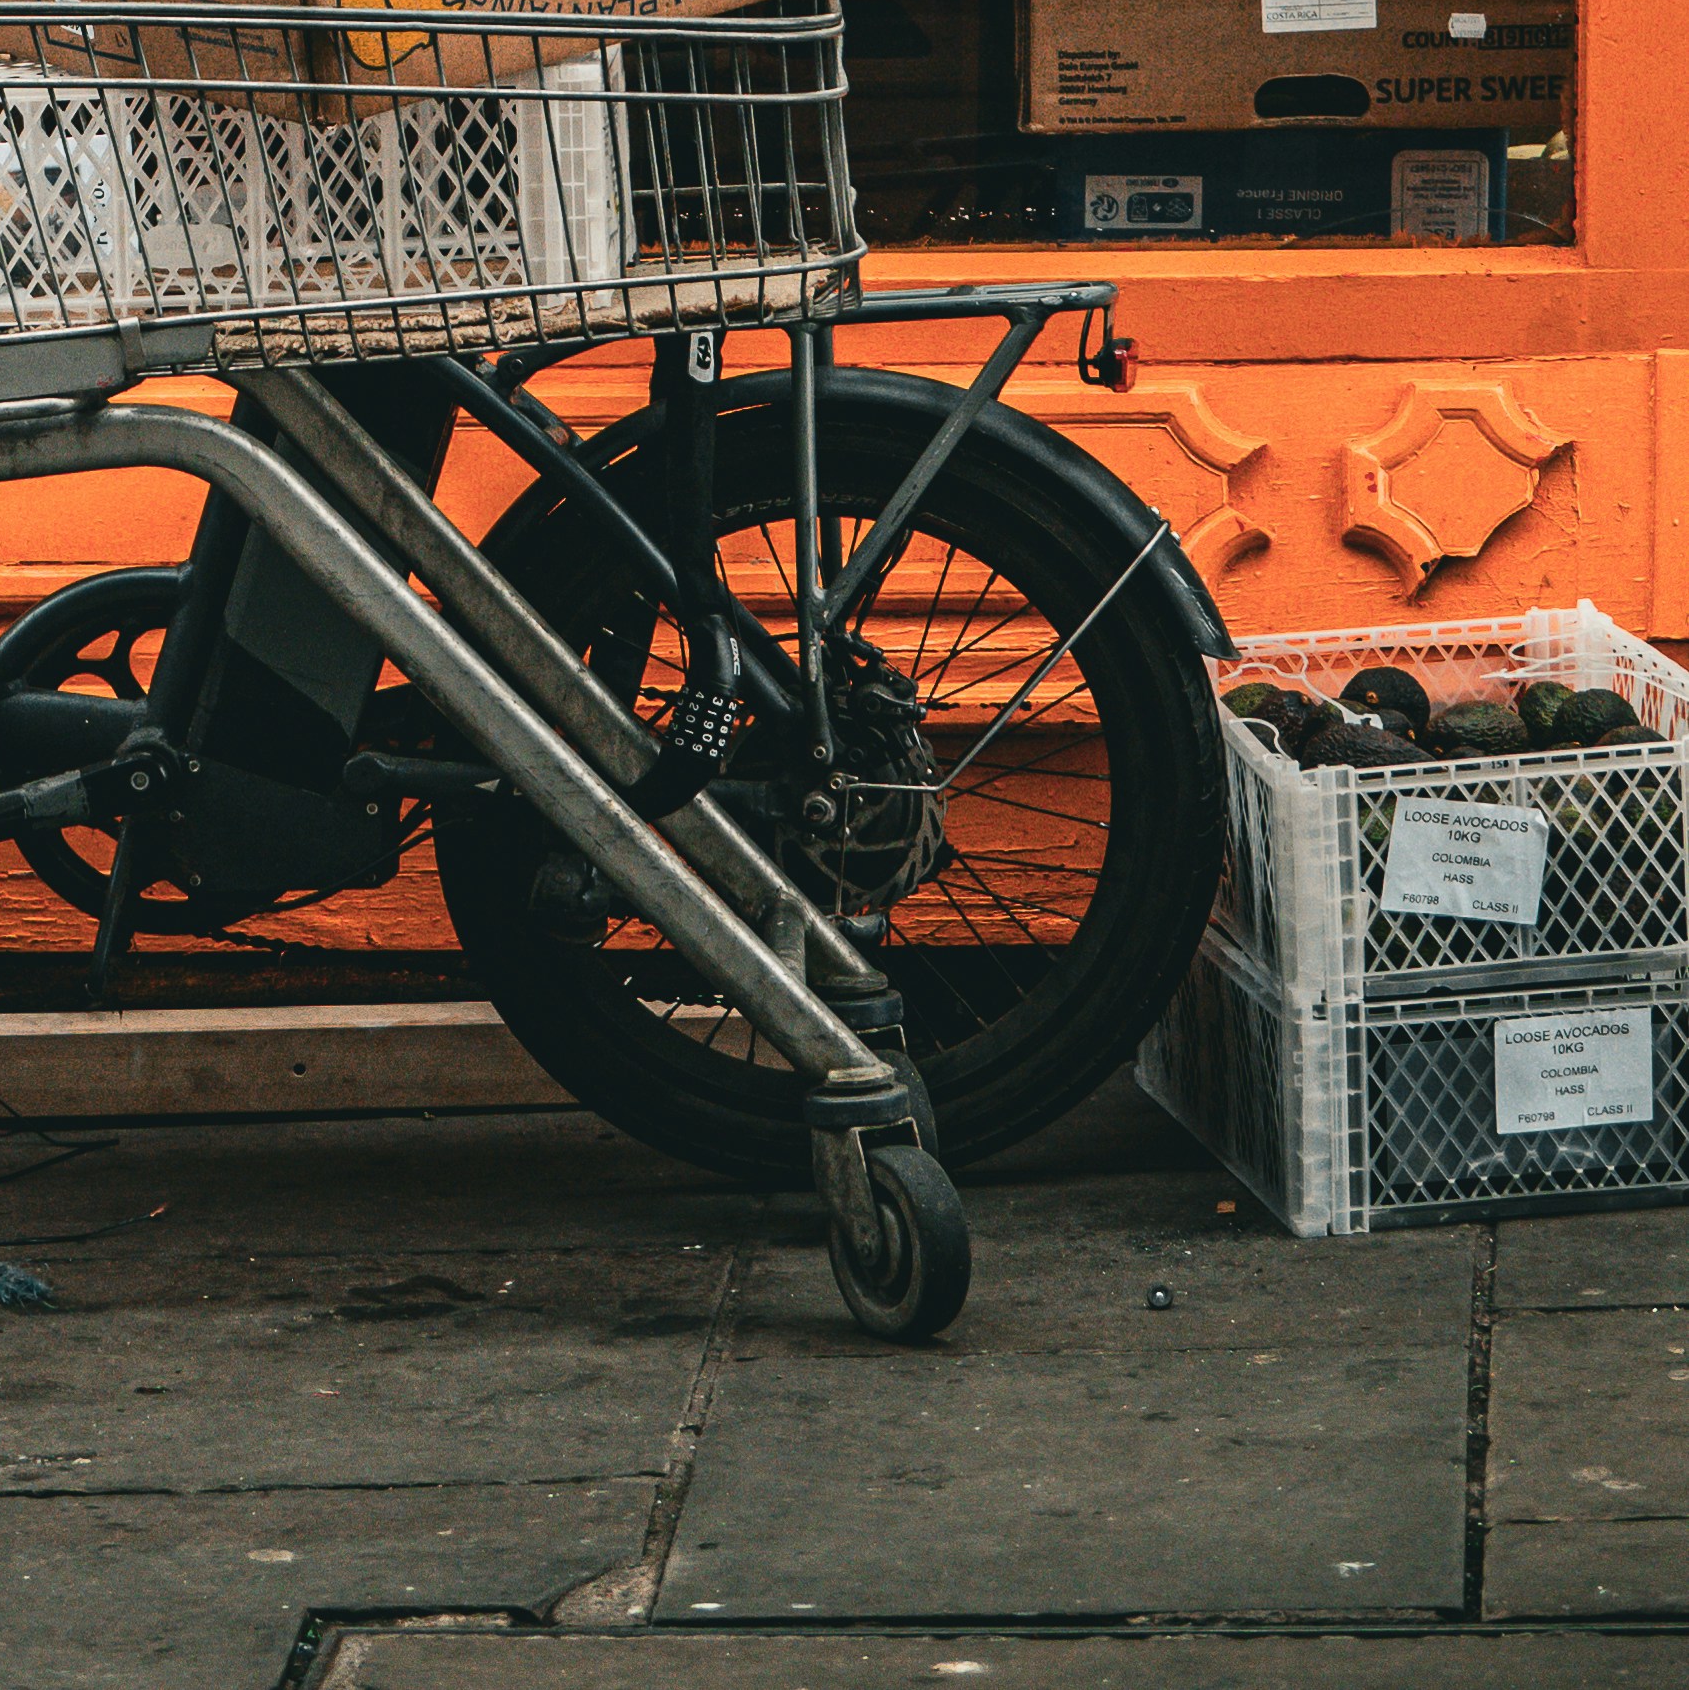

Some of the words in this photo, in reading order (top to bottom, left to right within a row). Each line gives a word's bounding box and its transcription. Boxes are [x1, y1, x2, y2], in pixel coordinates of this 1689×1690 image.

[1266, 11, 1296, 21] COSTA
[1298, 10, 1318, 20] RICA
[1375, 76, 1472, 104] SUPER
[1480, 74, 1566, 102] SWEE
[1235, 188, 1284, 200] France
[1287, 189, 1344, 201] ORIGINE
[1265, 208, 1322, 220] CLASSE
[1404, 810, 1450, 825] LOOSE
[1453, 815, 1530, 834] AVOCADOS
[1447, 829, 1482, 844] 10KG
[1431, 852, 1492, 868] COLOMBIA
[1443, 872, 1475, 885] HASS
[1402, 893, 1440, 906] F60798
[1472, 899, 1510, 913] CLASS
[1511, 904, 1519, 914] II
[1505, 1030, 1551, 1045] LOOSE
[1554, 1023, 1630, 1041] AVOCADOS
[1552, 1042, 1585, 1055] 10KG
[1540, 1064, 1599, 1079] COLOMBIA
[1554, 1084, 1586, 1096] HASS
[1518, 1111, 1555, 1124] F60798
[1586, 1104, 1624, 1117] CLASS
[1626, 1104, 1634, 1114] II
